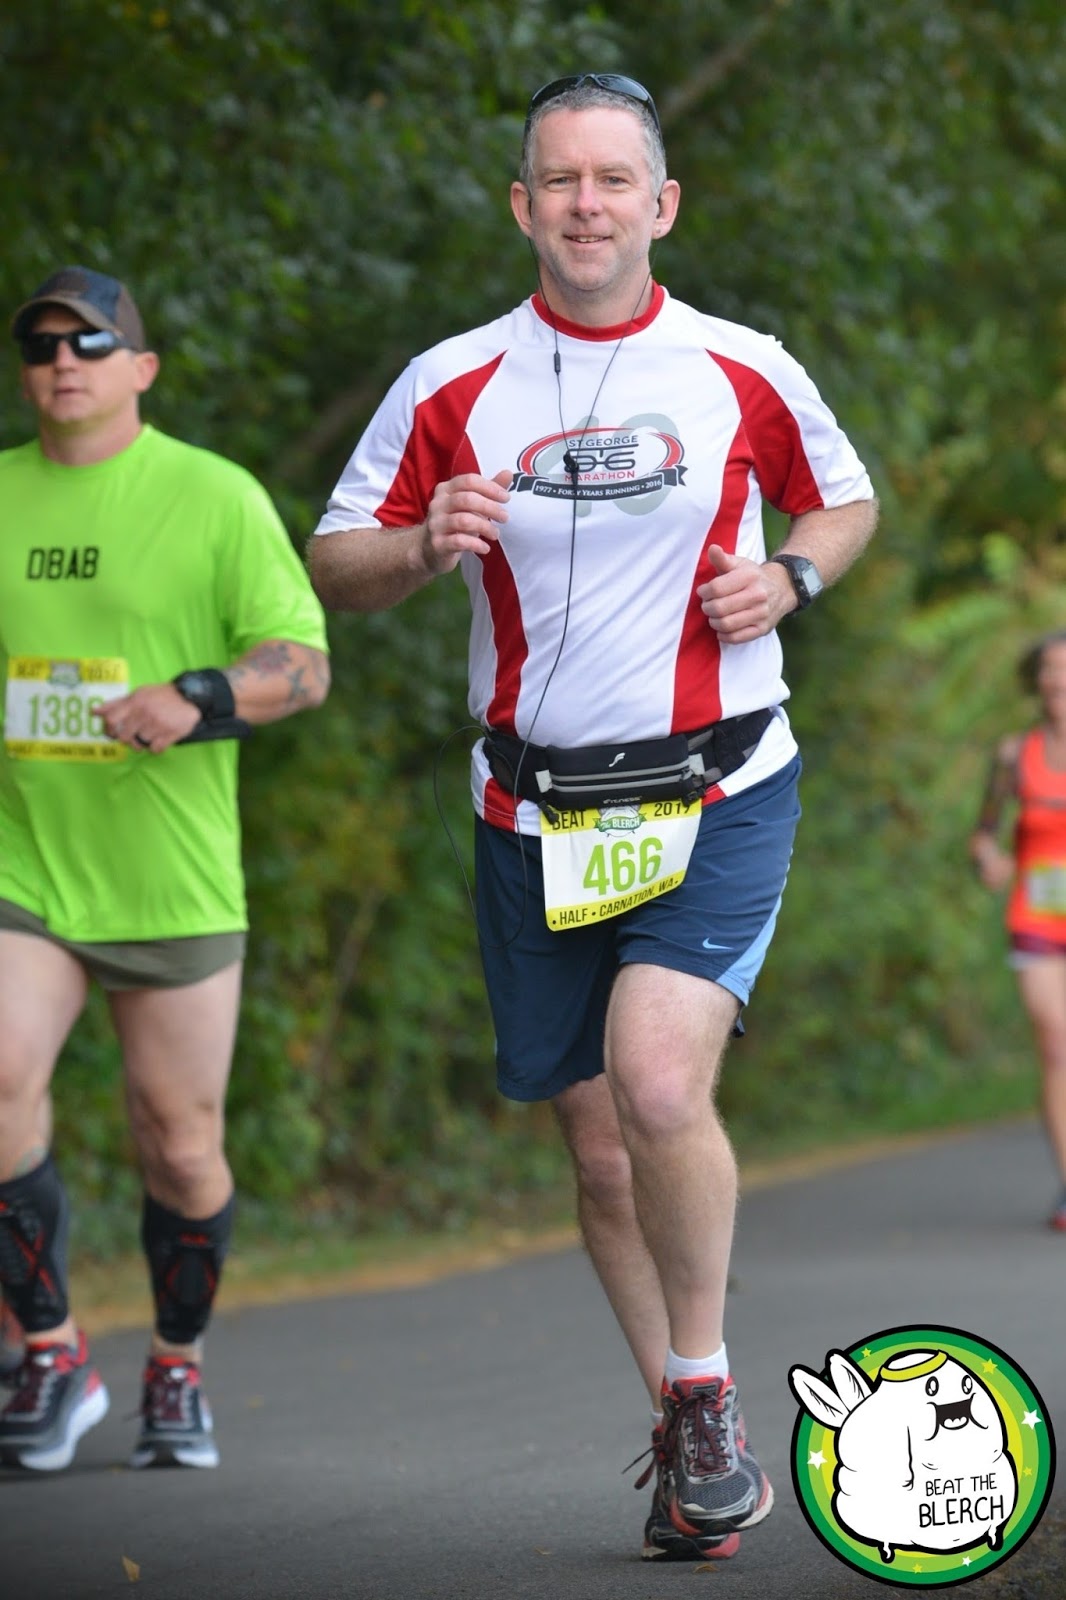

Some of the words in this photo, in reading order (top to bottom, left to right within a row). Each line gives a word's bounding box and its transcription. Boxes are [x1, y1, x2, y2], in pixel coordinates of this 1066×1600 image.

[569, 439, 583, 448] ST
[585, 435, 639, 447] GEORGE
[564, 470, 636, 483] MARATHON
[535, 484, 553, 494] 1977
[557, 487, 582, 497] FORY
[582, 488, 604, 497] YEARS
[605, 484, 641, 497] RUNNING
[645, 479, 662, 489] 2016
[28, 693, 104, 737] 1386
[552, 809, 586, 831] BEAT
[612, 816, 640, 829] BLERCH
[582, 836, 664, 896] 466
[559, 907, 588, 926] HALF
[658, 877, 674, 891] WA
